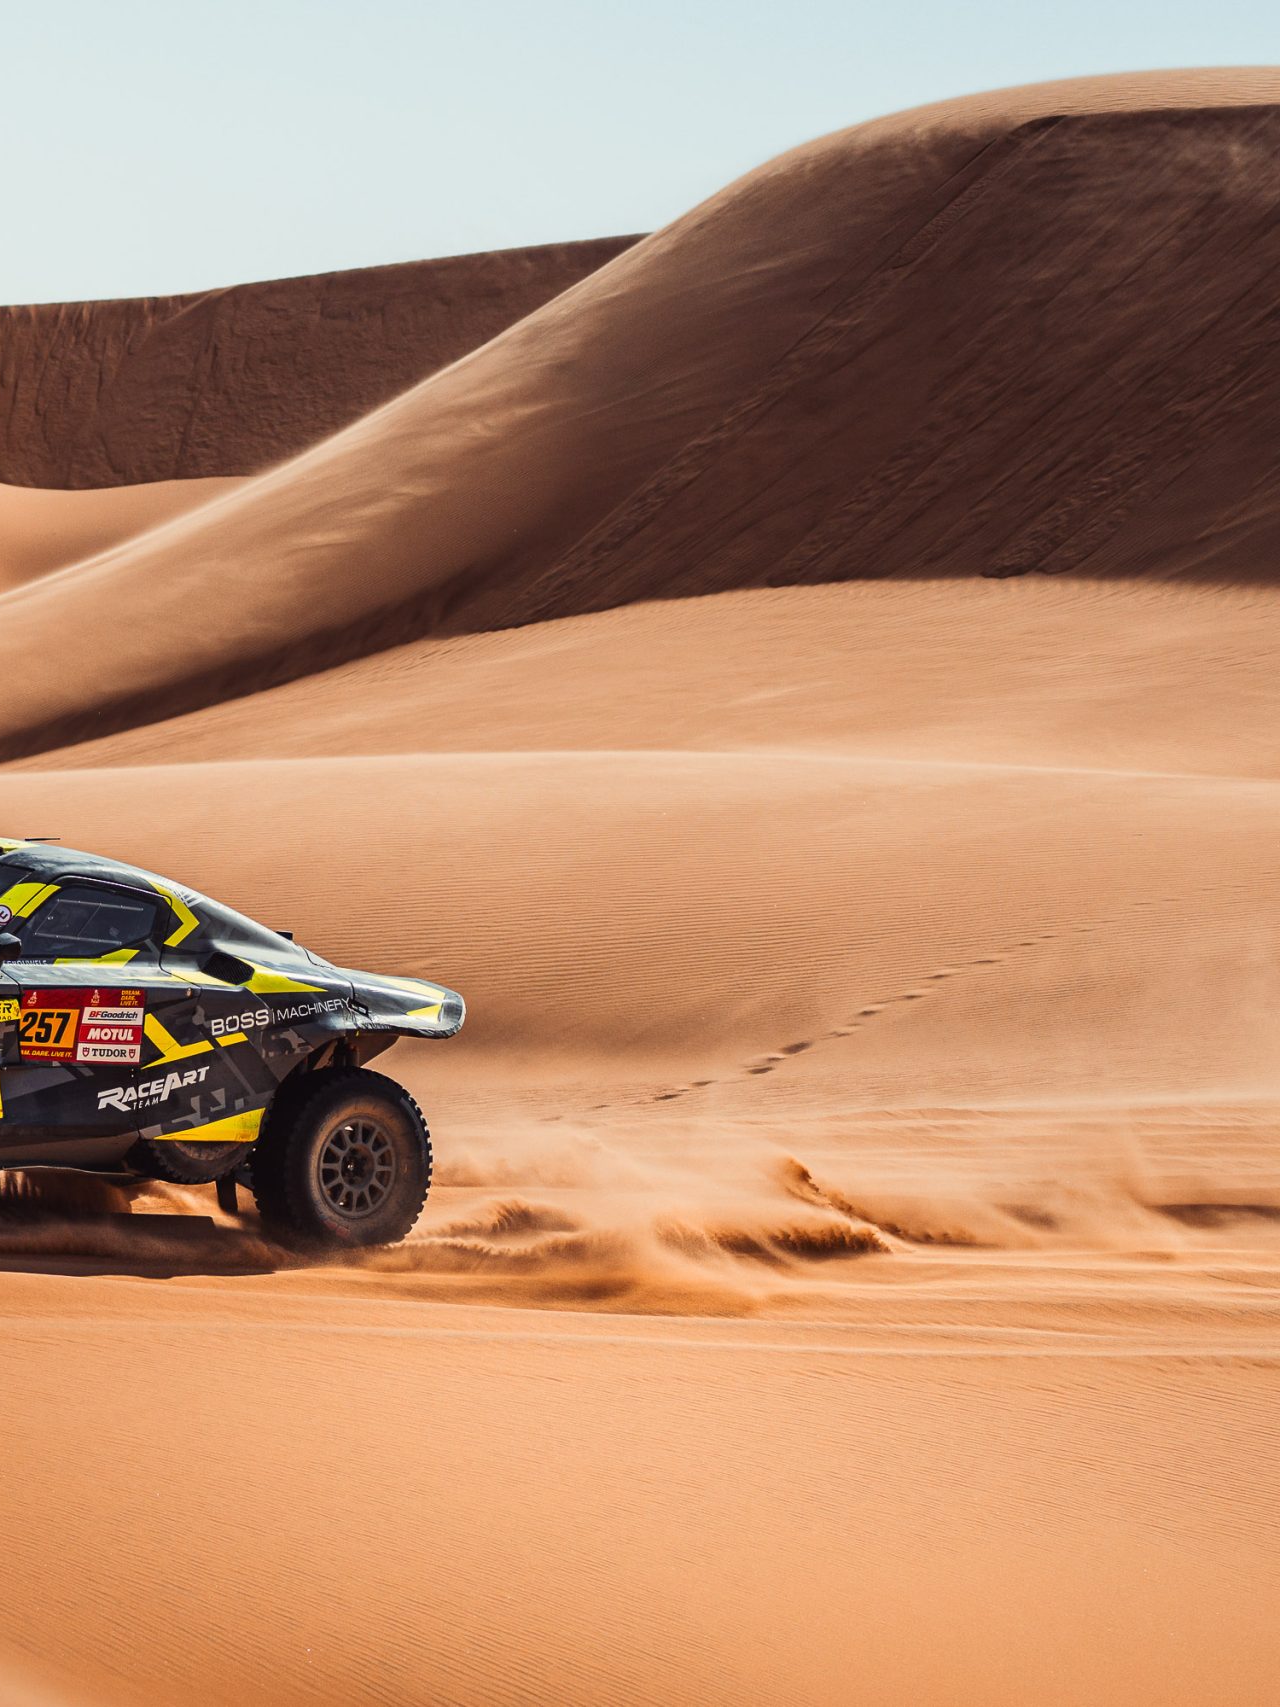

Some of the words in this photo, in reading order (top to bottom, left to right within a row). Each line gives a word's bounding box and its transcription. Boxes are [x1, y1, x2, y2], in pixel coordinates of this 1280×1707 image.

[88, 1010, 138, 1019] BFGoodrich
[211, 1008, 270, 1036] BOSS
[277, 997, 351, 1021] MACHINERY
[20, 1011, 71, 1044] 257
[86, 1027, 134, 1041] MOTUL
[91, 1048, 127, 1057] TUDOR
[133, 1096, 159, 1110] TEAM
